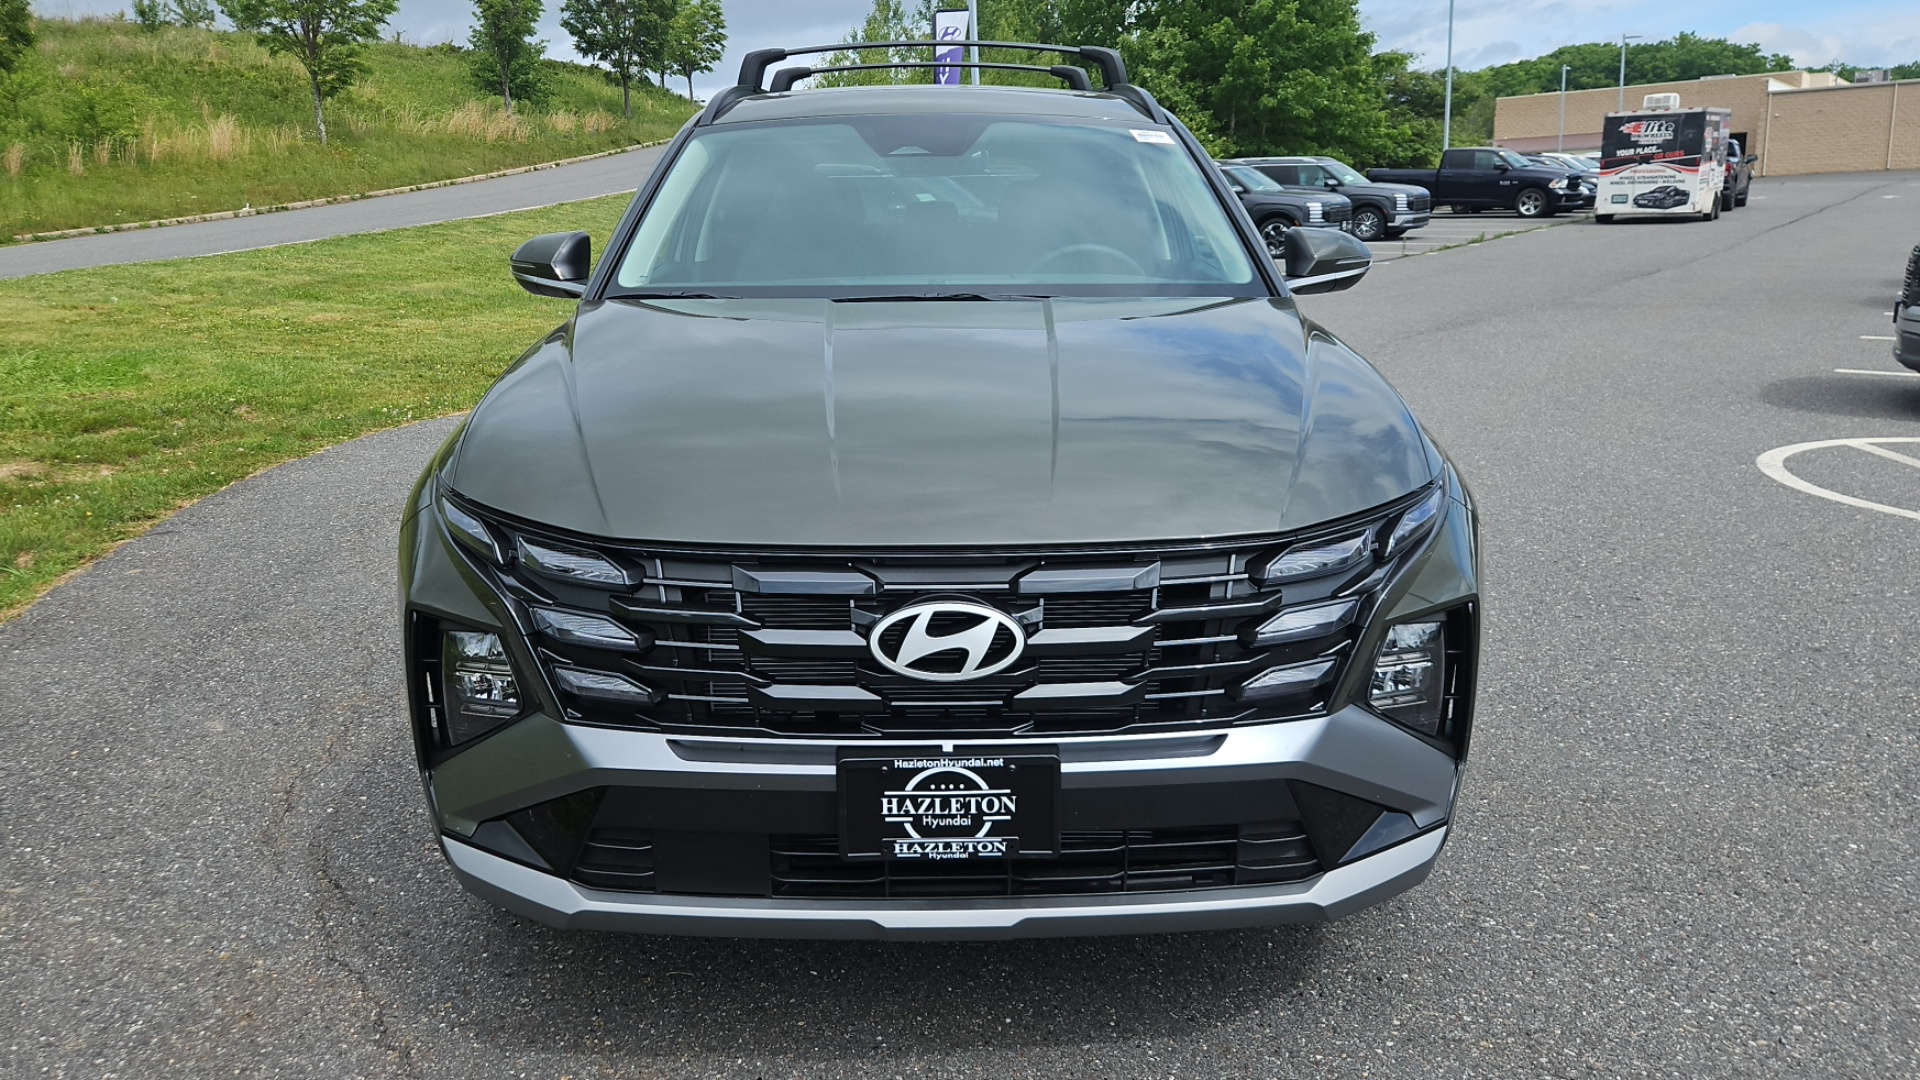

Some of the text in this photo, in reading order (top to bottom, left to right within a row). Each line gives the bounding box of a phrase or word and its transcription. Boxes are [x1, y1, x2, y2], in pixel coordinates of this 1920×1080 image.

[1621, 121, 1675, 133] Elite
[1616, 148, 1635, 156] YOUR
[894, 758, 1004, 769] HazletonHyundai.net
[881, 796, 1017, 815] HAZLETON
[922, 815, 971, 829] Hyundai
[893, 842, 1007, 854] HAZLETON
[928, 852, 969, 860] Hyundai
